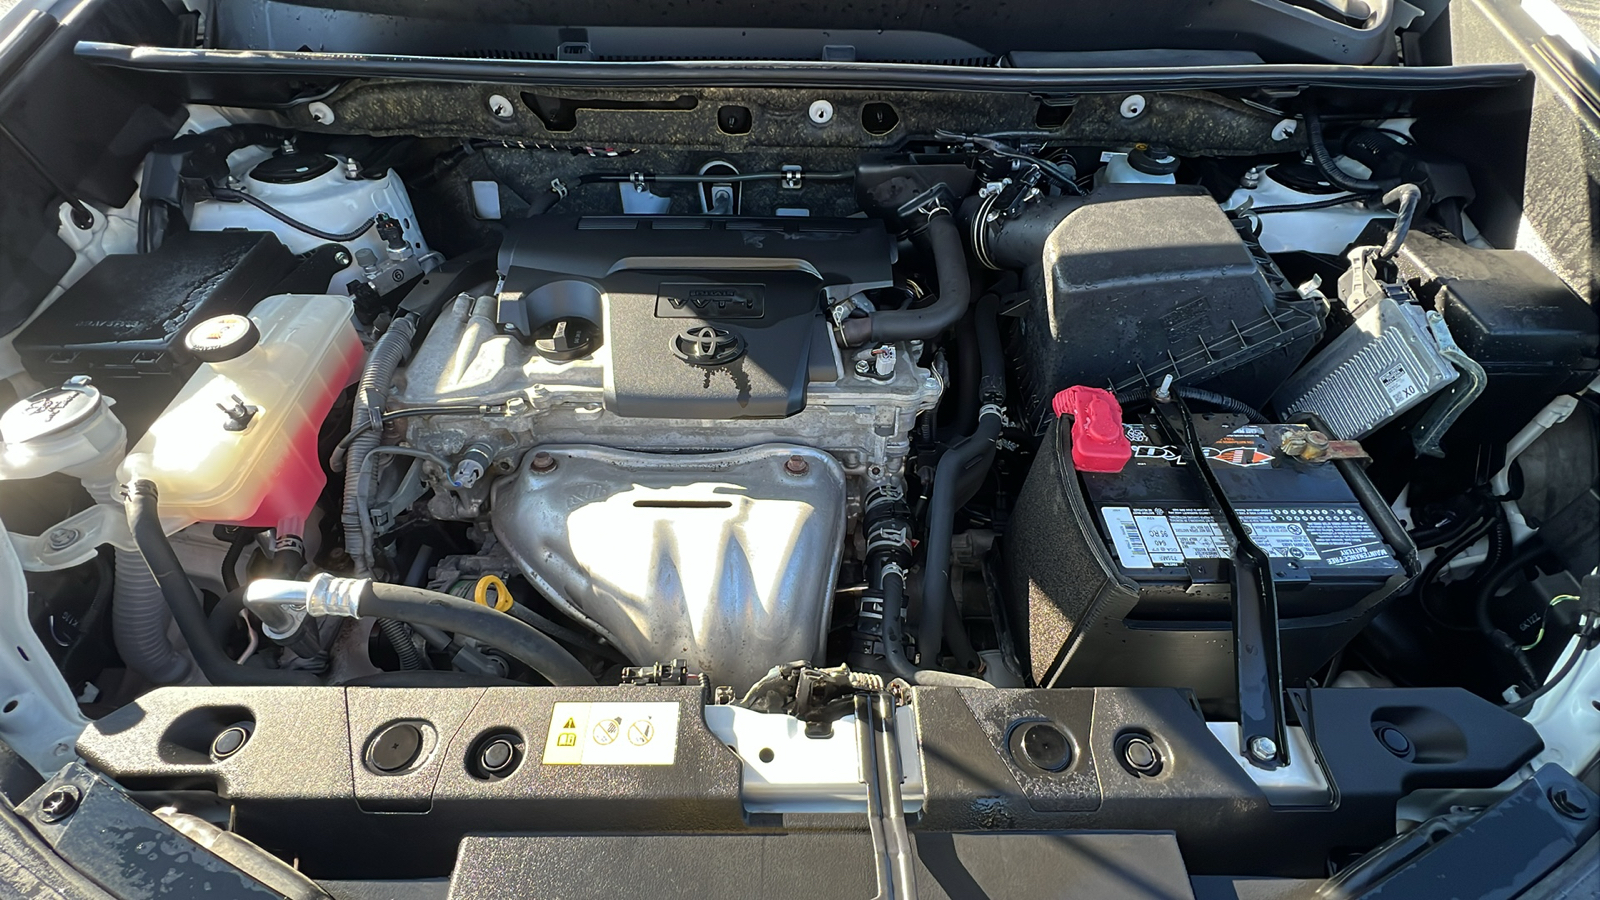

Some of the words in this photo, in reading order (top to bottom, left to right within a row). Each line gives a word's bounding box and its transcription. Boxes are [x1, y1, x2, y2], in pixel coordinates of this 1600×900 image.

[1149, 530, 1160, 538] RC
[1326, 548, 1388, 565] MAINTENANCE-FREE
[1340, 546, 1368, 557] BATTERY
